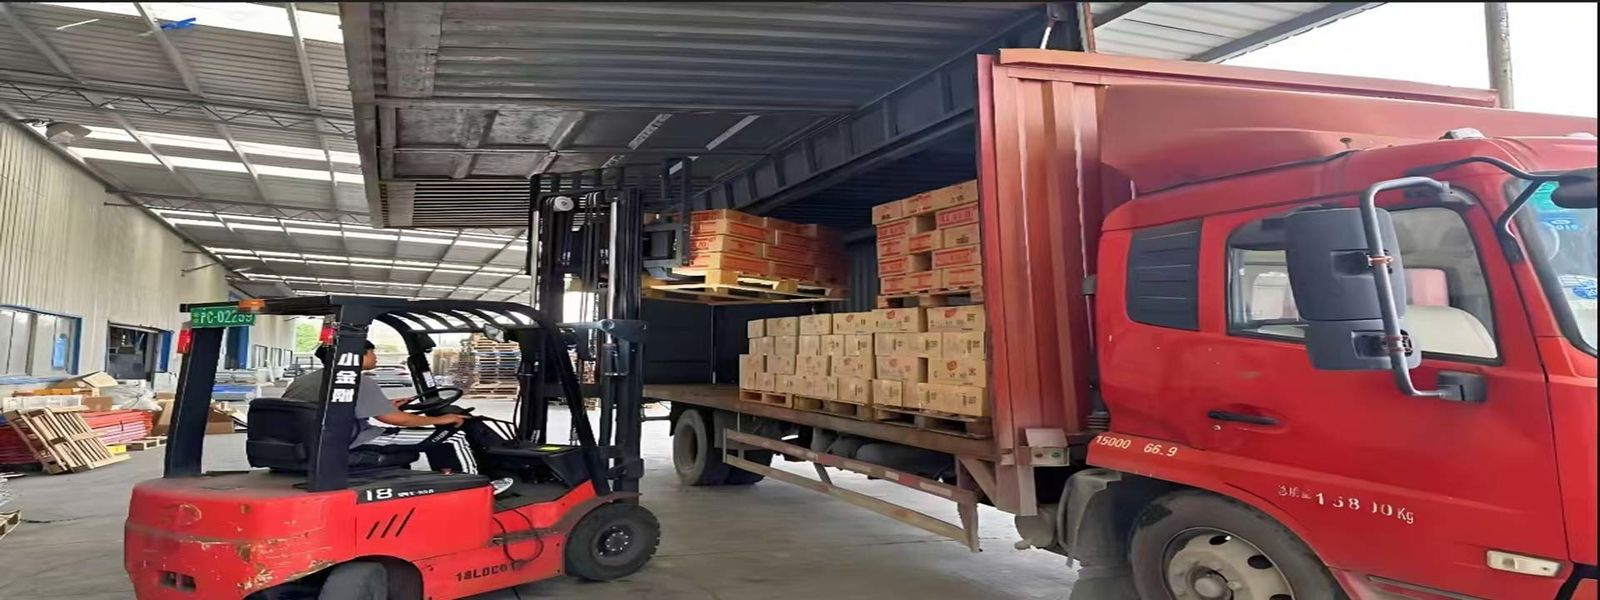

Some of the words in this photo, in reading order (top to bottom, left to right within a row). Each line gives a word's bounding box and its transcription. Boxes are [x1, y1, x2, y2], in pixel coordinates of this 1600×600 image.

[1096, 436, 1131, 449] 15000
[1144, 443, 1178, 457] 66.9
[366, 488, 393, 501] 18
